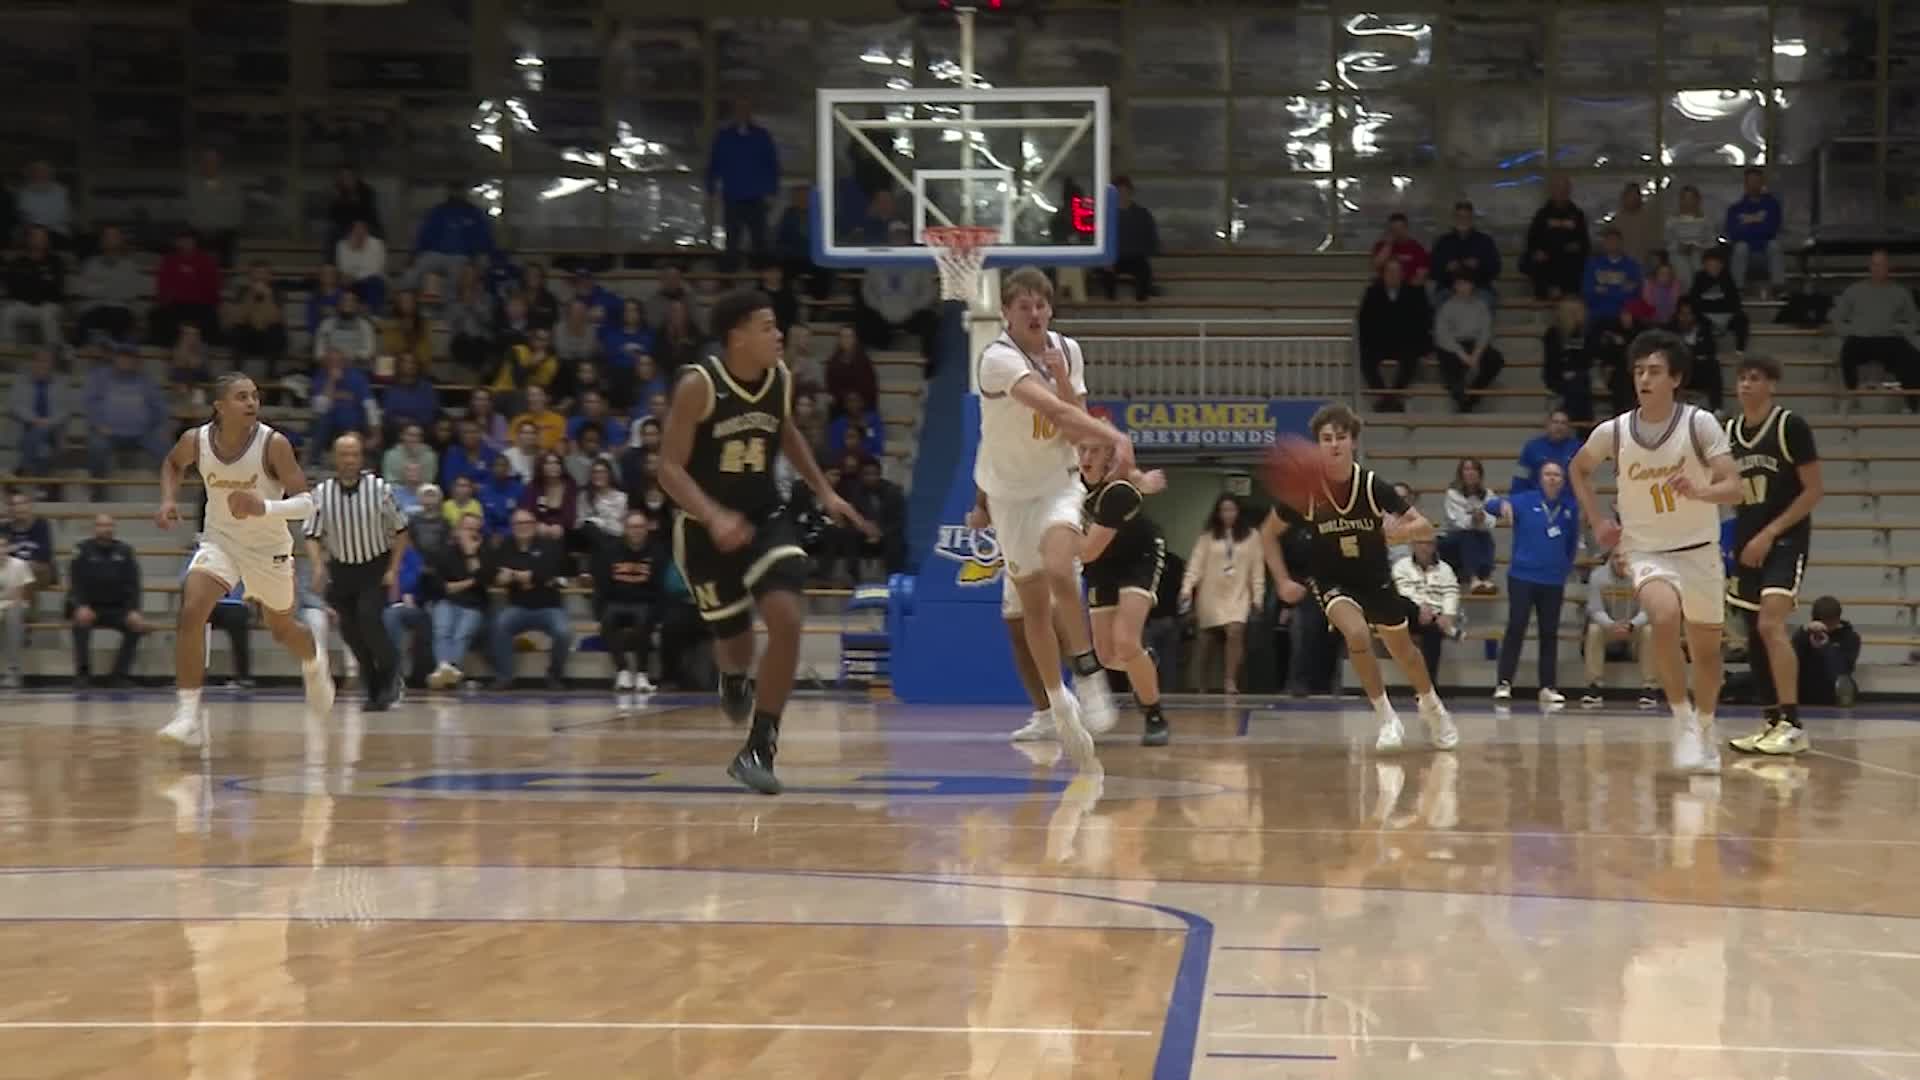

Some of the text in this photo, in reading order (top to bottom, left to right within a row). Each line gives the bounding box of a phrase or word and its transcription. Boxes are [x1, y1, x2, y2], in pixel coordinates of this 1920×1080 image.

[1125, 403, 1277, 428] CARMEL
[1130, 431, 1277, 444] GREYHOUNDS
[1649, 483, 1676, 515] 11
